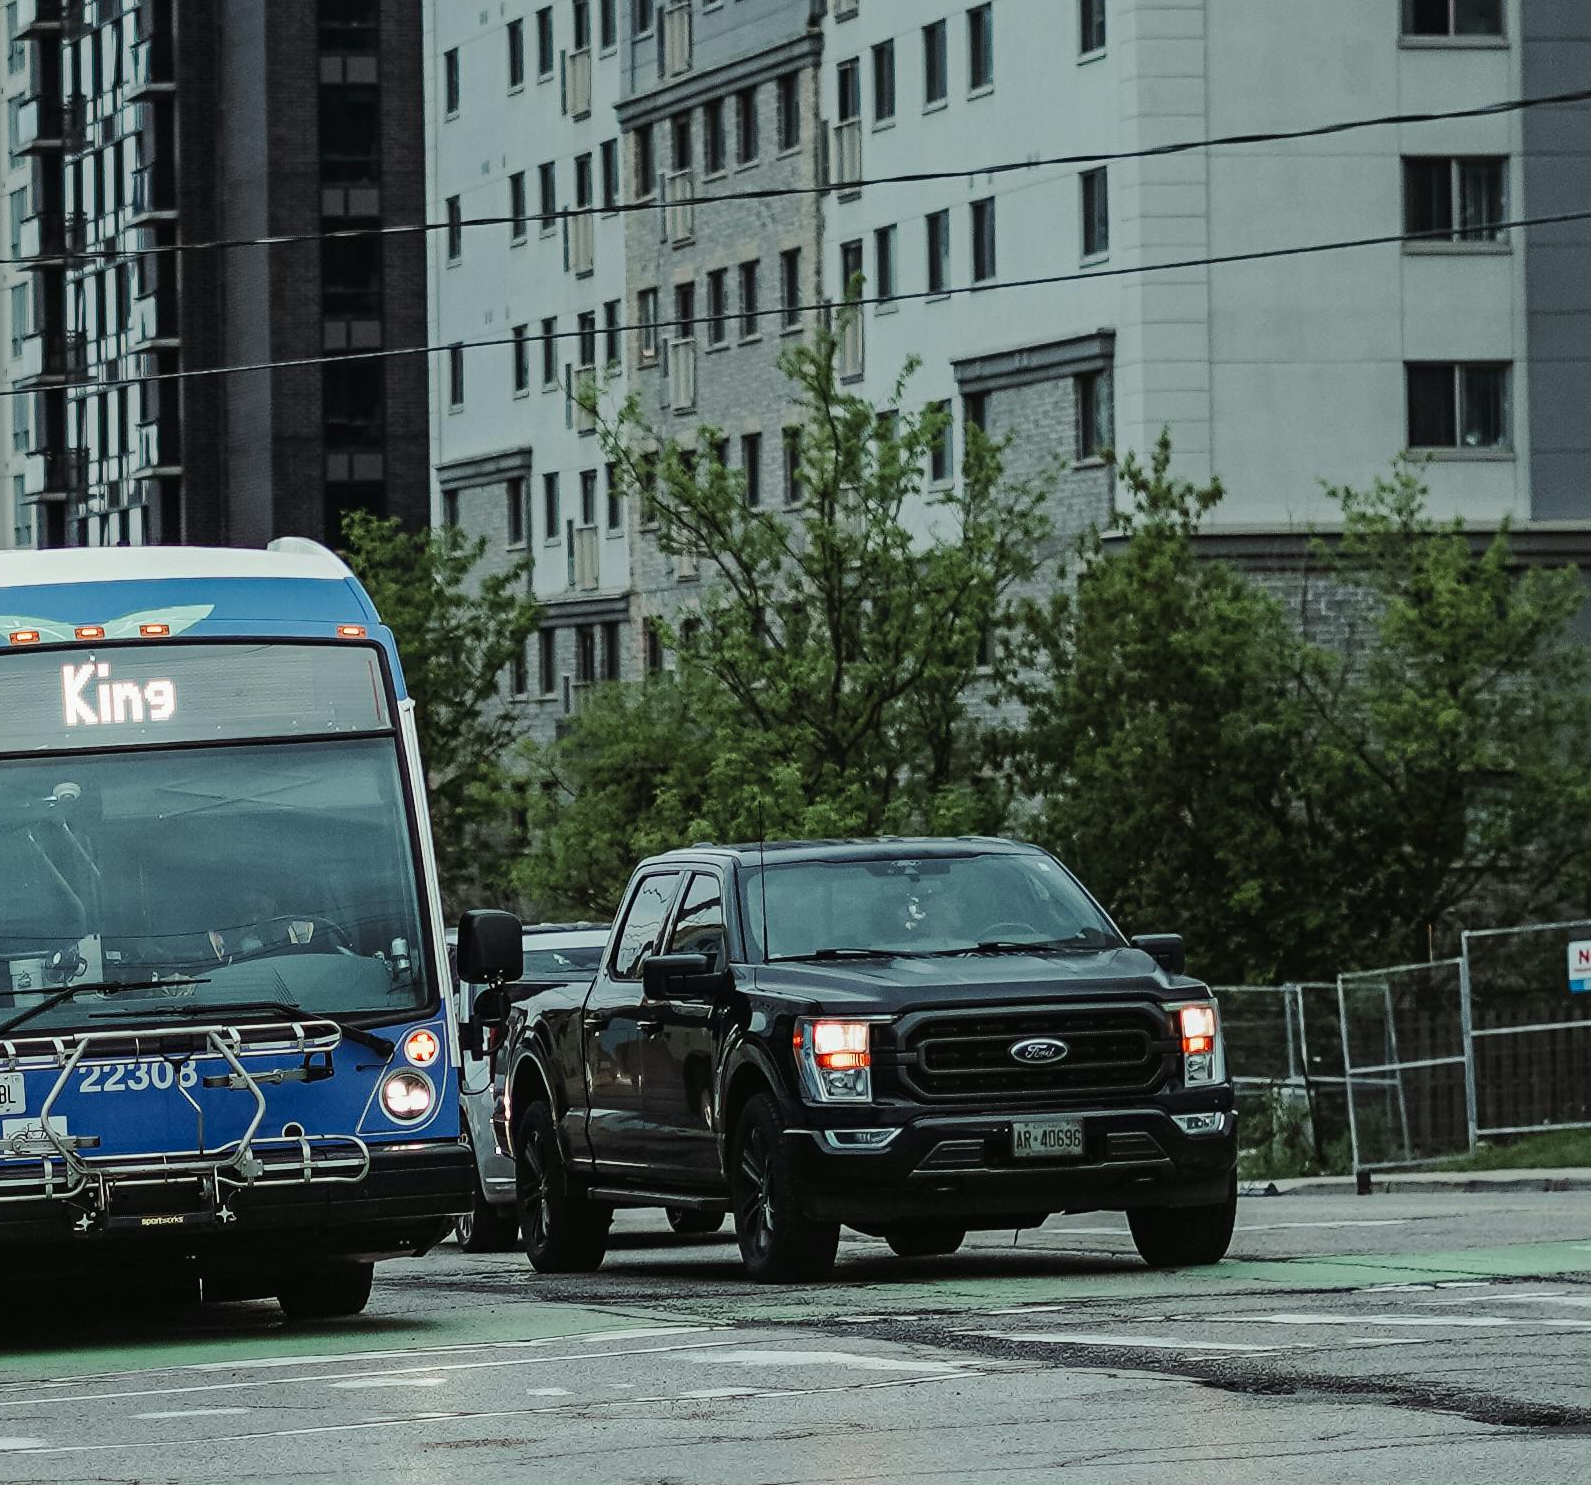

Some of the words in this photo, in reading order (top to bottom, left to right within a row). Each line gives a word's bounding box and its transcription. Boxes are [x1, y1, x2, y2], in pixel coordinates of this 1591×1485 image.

[63, 663, 175, 725] King
[79, 1061, 198, 1093] 22308
[1016, 1130, 1032, 1150] AR
[1040, 1128, 1081, 1148] 40696
